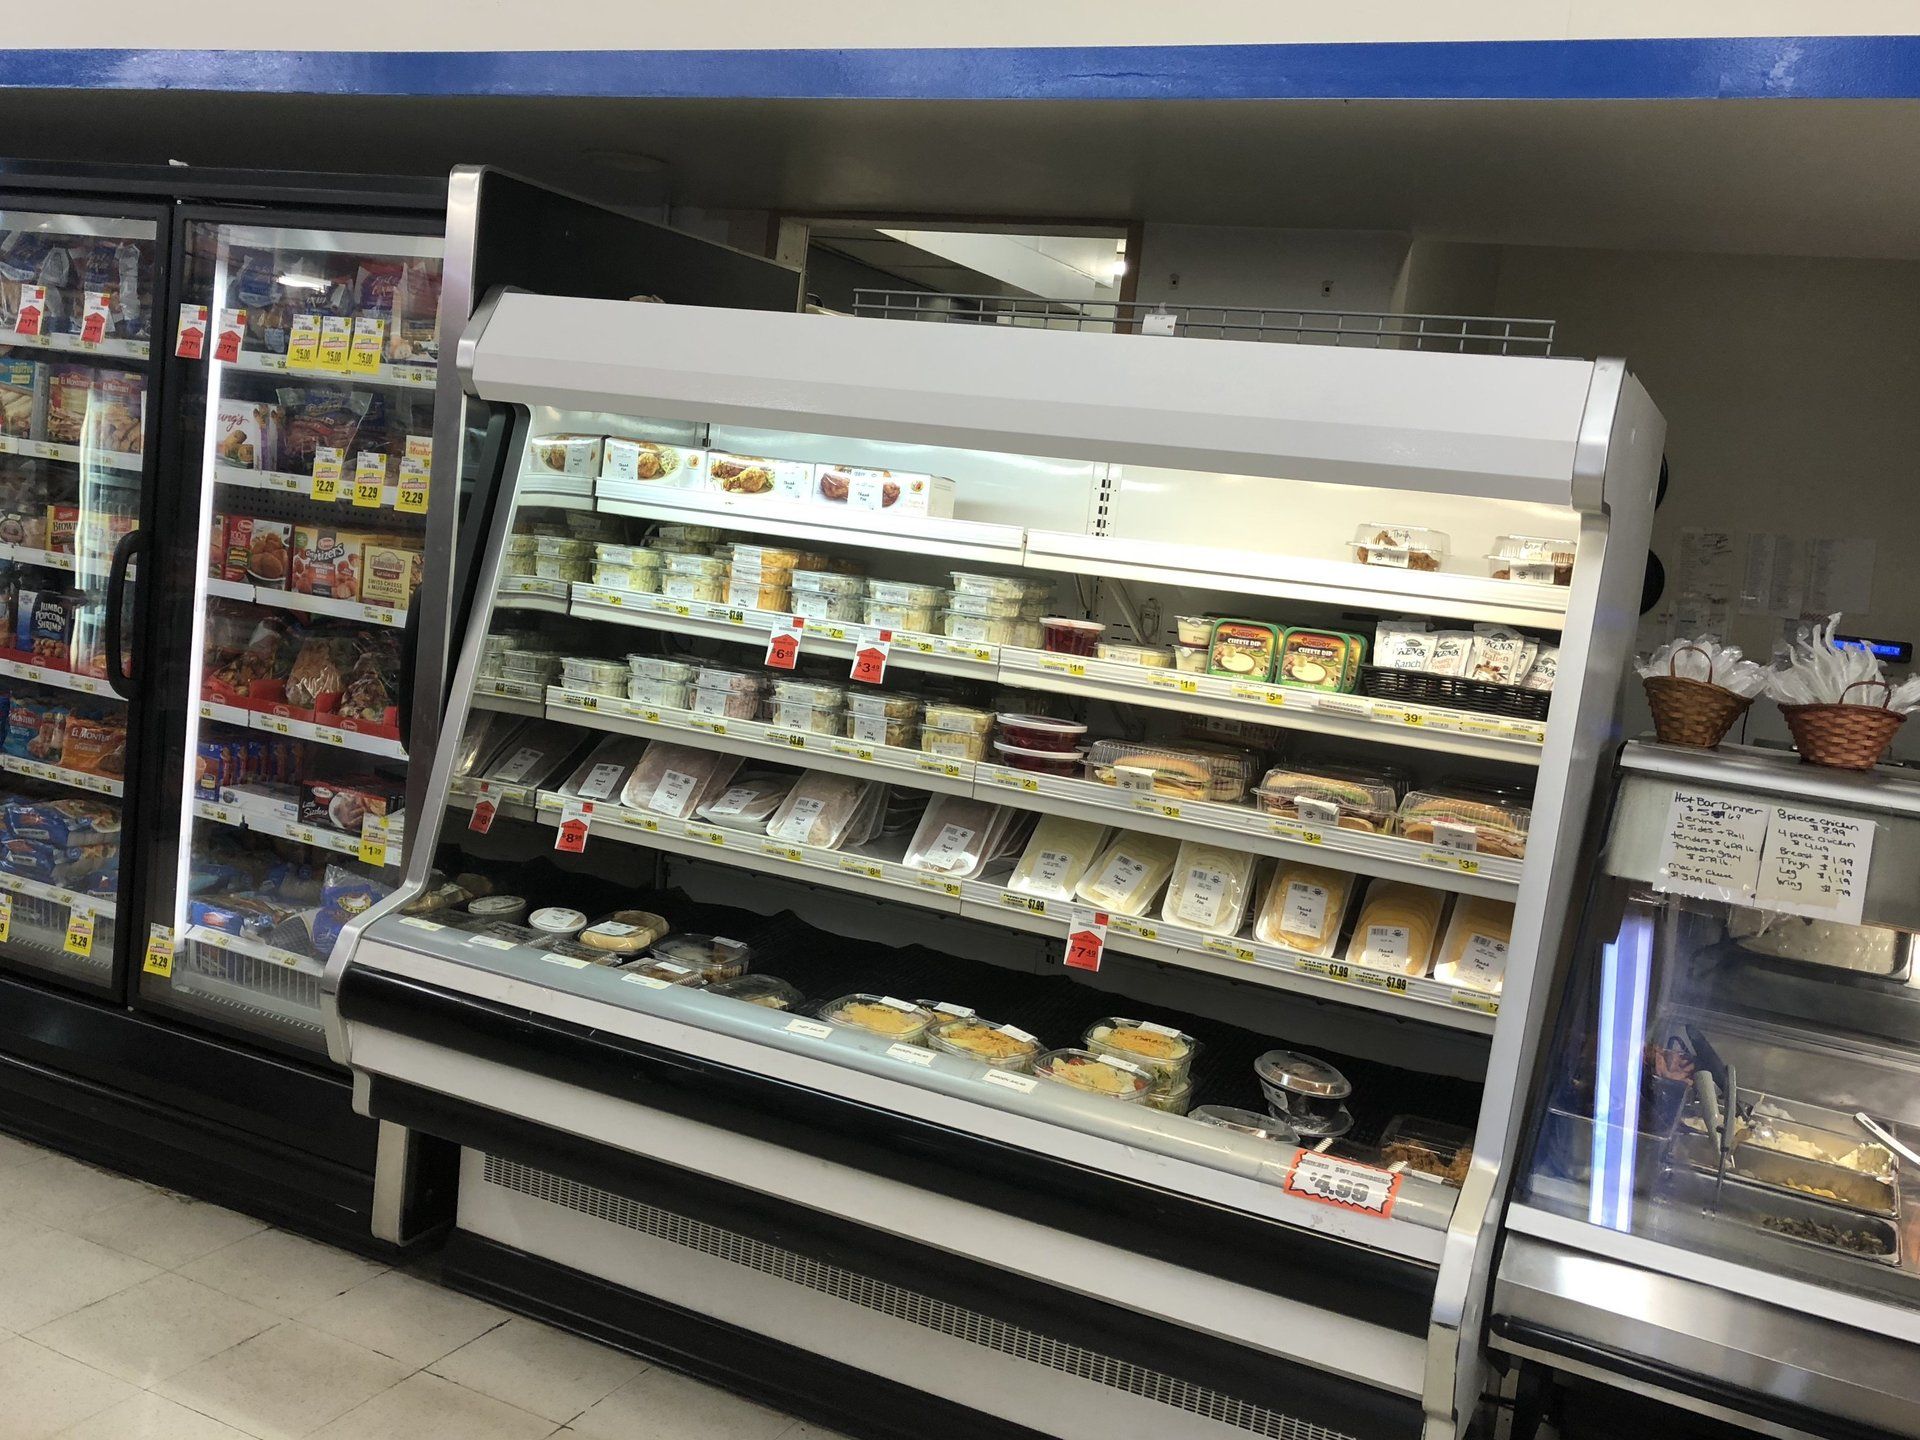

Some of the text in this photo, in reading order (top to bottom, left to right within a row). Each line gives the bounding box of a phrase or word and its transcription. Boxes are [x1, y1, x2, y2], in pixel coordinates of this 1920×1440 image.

[316, 480, 334, 492] $2.29
[358, 486, 378, 498] $2.29
[402, 490, 422, 504] $2.29
[372, 584, 402, 595] MUSHROOM
[40, 602, 62, 614] JUMBO
[36, 612, 66, 626] POPCORN
[728, 610, 744, 622] $7.99
[38, 620, 62, 632] SHRIMP
[1249, 640, 1262, 648] DIP
[1394, 658, 1420, 668] Ranch
[1482, 651, 1509, 662] Italian
[1674, 792, 1763, 814] Hot Bar Dinner
[1780, 867, 1797, 880] Leg
[1028, 898, 1044, 912] $7.99
[70, 934, 88, 948] $5.29
[150, 954, 168, 968] $5.29
[1328, 963, 1348, 978] $7.99
[1386, 976, 1407, 991] $7.99
[1310, 1172, 1370, 1202] $4.99
